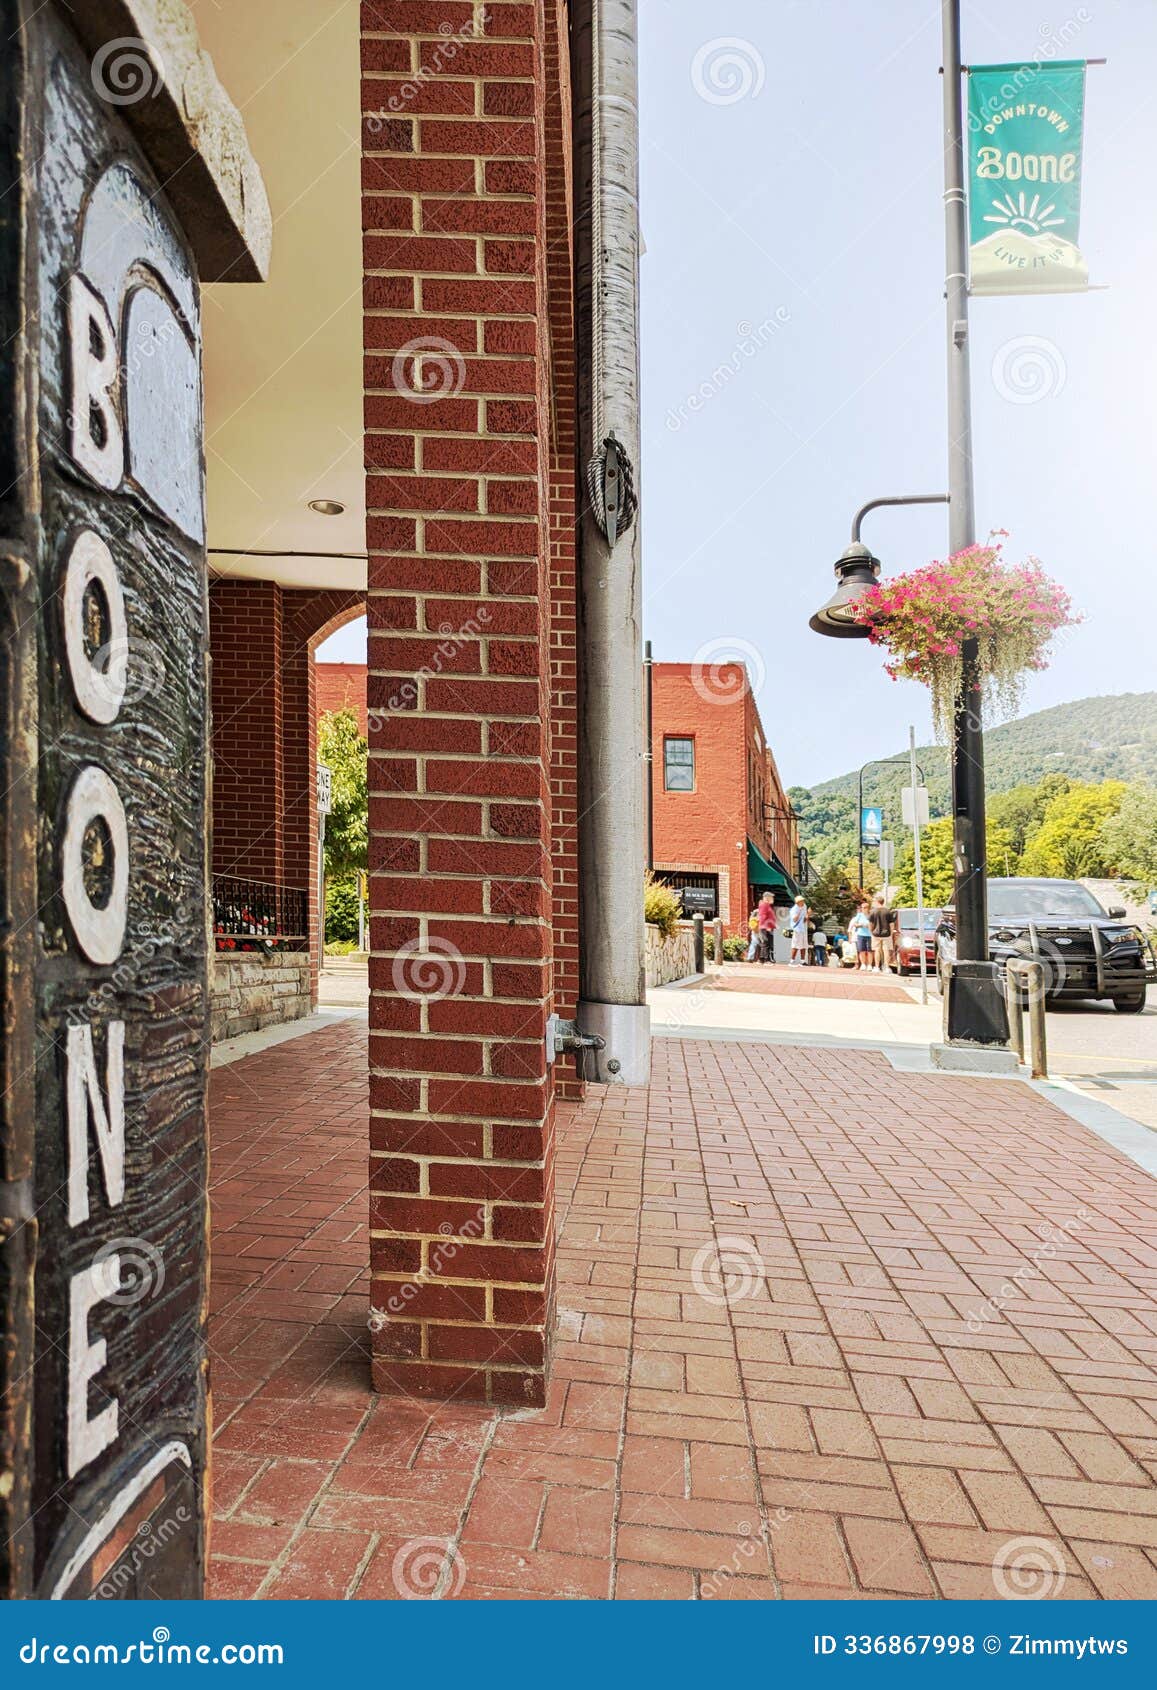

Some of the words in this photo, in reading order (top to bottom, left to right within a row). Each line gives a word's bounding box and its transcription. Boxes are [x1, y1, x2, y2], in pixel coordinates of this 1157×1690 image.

[983, 103, 1069, 135] DOWNTOWN
[976, 146, 1079, 183] Boone
[994, 246, 1025, 268] LIVE
[1032, 253, 1048, 268] IT
[1049, 247, 1067, 264] UP
[62, 272, 129, 1480] BOONE
